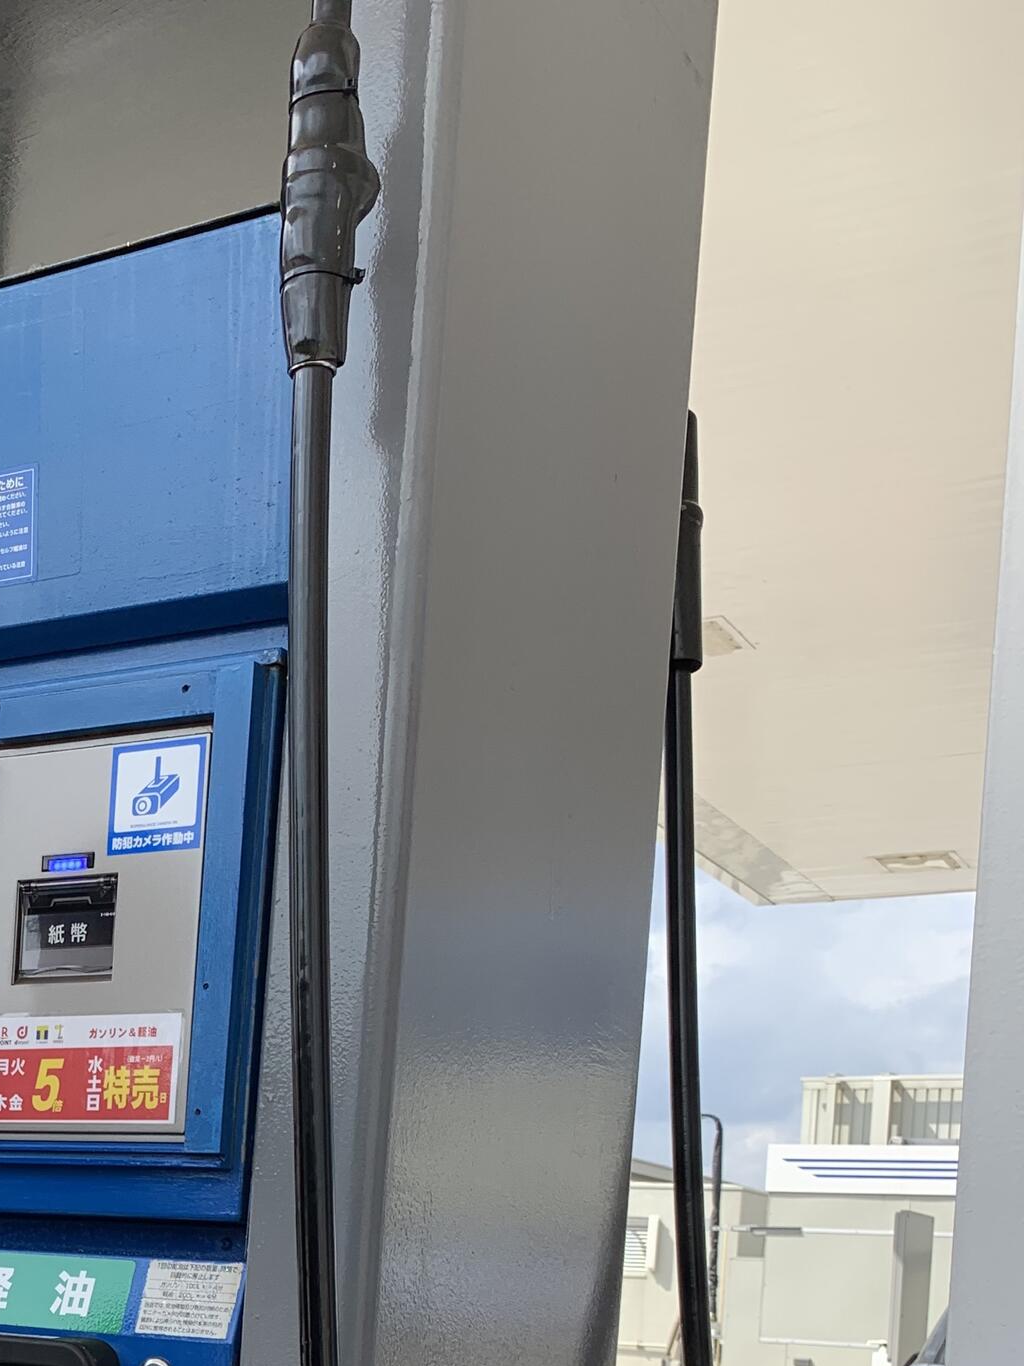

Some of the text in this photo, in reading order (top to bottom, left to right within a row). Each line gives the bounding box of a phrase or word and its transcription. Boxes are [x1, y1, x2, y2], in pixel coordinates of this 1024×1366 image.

[111, 830, 195, 851] 防犯カメラ作動中
[47, 921, 88, 944] 紙幣
